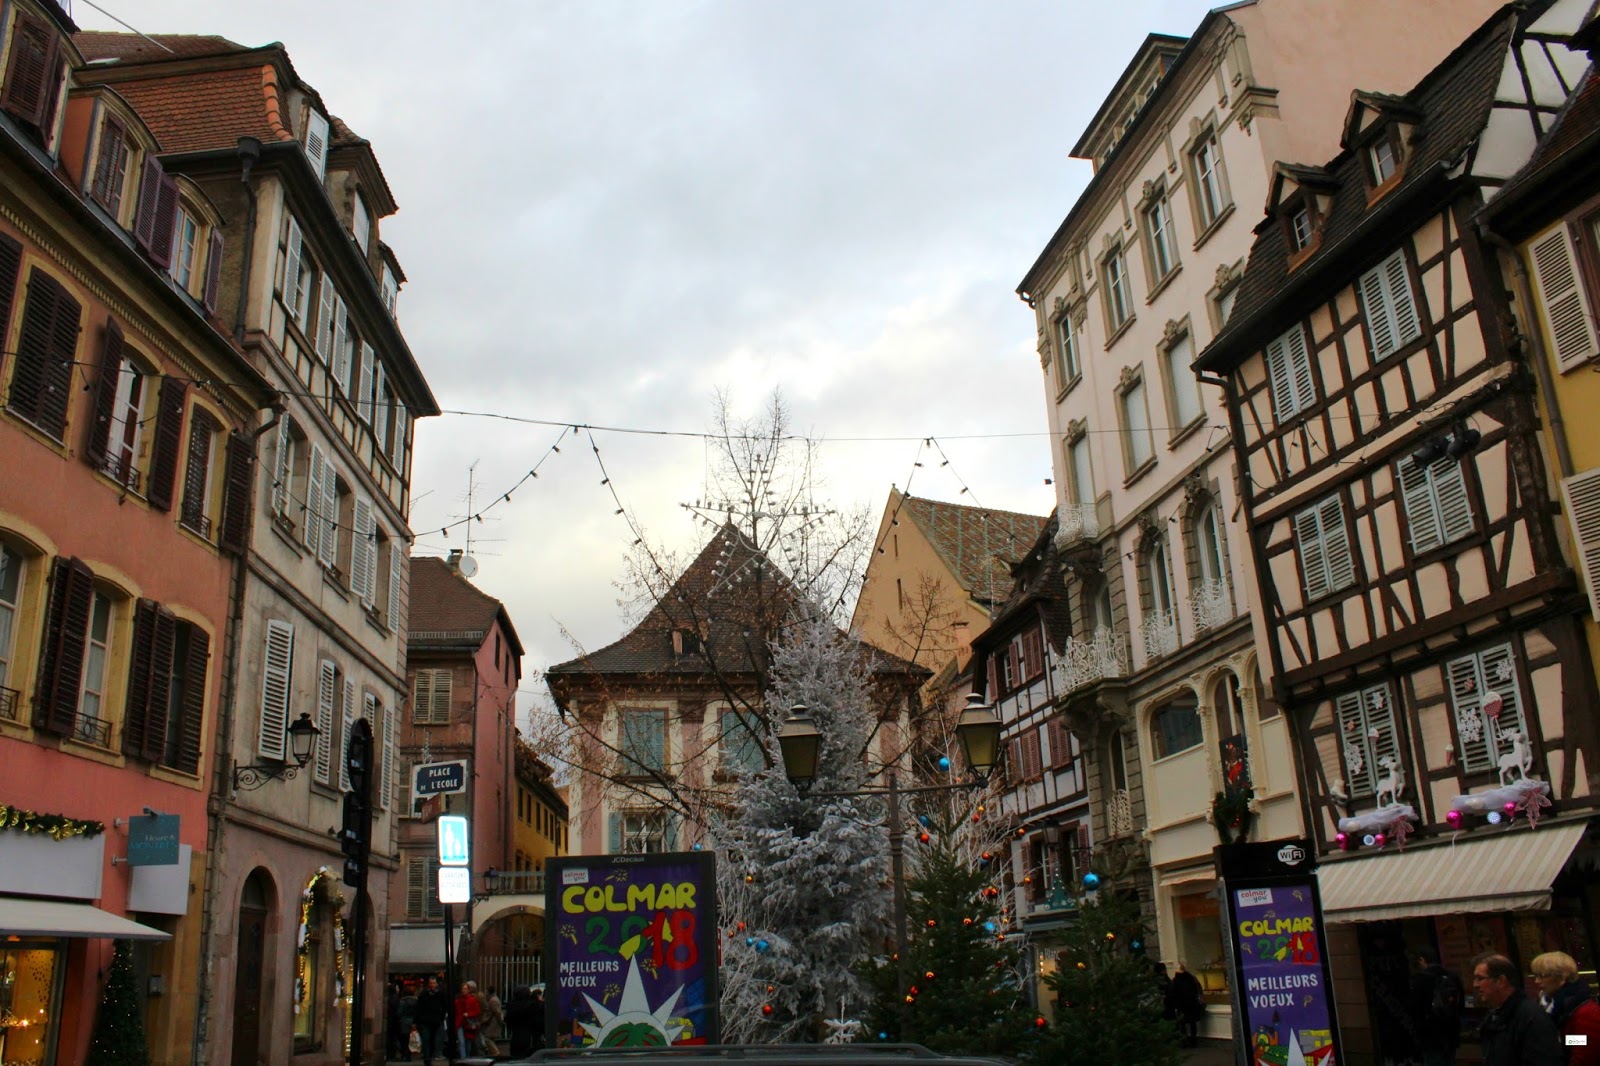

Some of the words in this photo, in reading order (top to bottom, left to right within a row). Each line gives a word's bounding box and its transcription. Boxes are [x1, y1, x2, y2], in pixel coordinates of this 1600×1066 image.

[429, 767, 451, 777] PLACE
[431, 779, 458, 789] L'ECOLE
[611, 856, 645, 864] JCDecaux
[562, 882, 697, 914] COLMAR
[1241, 889, 1268, 898] colmar
[1253, 895, 1268, 904] you
[1239, 916, 1314, 937] COLMAR
[585, 909, 699, 971] 2018
[1257, 932, 1319, 967] 2018
[559, 961, 620, 974] MEILLEURS
[560, 975, 597, 987] VOEUX
[1248, 973, 1319, 992] MEILLEURS
[1250, 993, 1295, 1009] VOEUX
